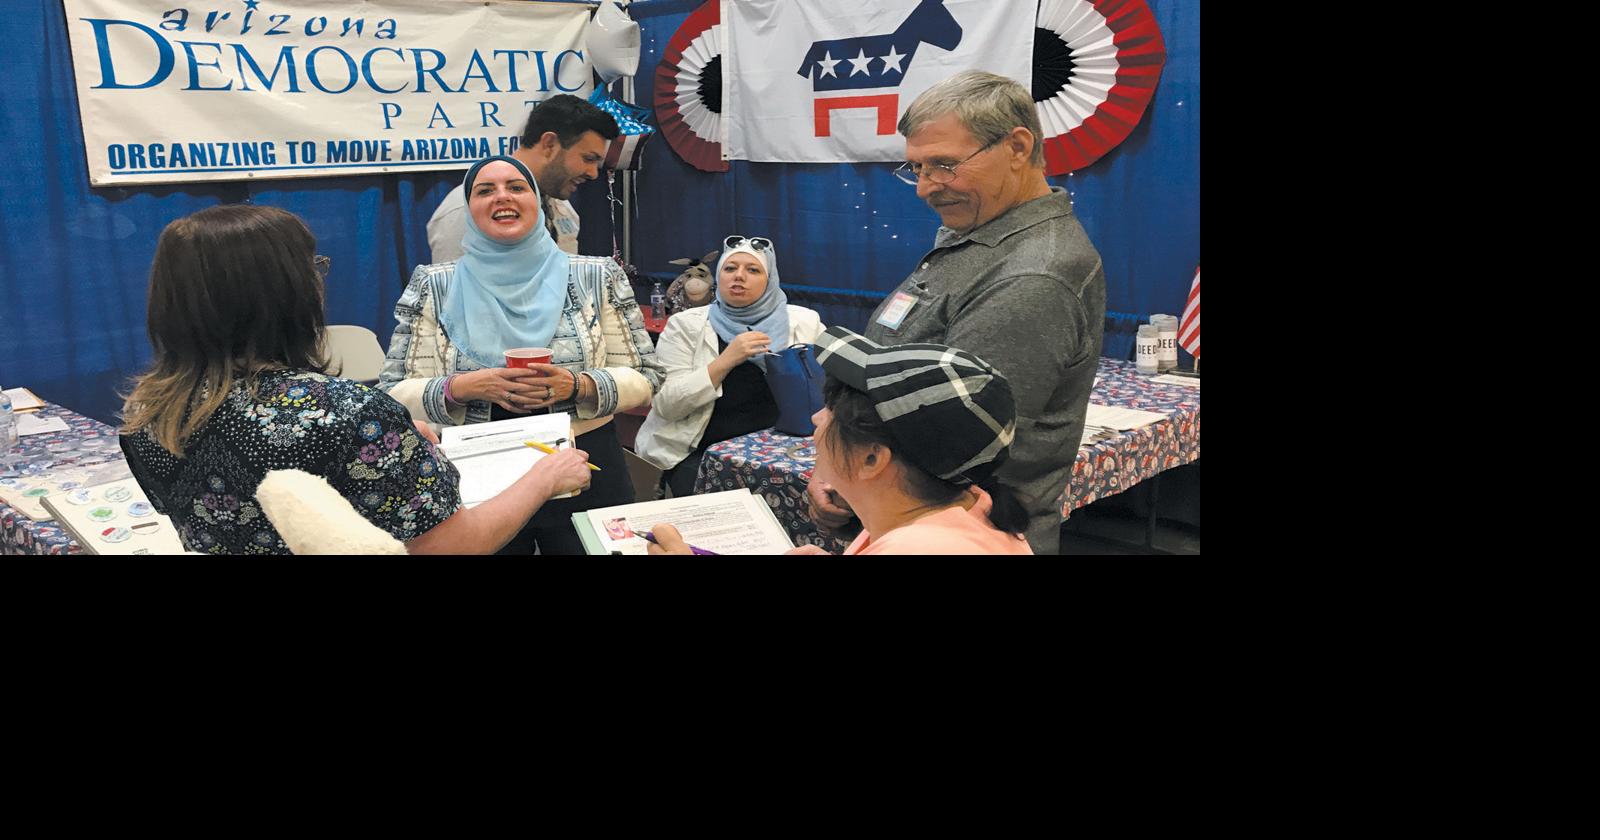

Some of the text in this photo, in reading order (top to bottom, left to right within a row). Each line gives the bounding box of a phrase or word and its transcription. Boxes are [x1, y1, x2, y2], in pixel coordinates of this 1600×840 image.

[158, 0, 397, 40] arizona
[79, 17, 586, 94] DEMOCRATIC
[107, 135, 523, 170] ORGANIZING TO MOVE ARIZONA FO
